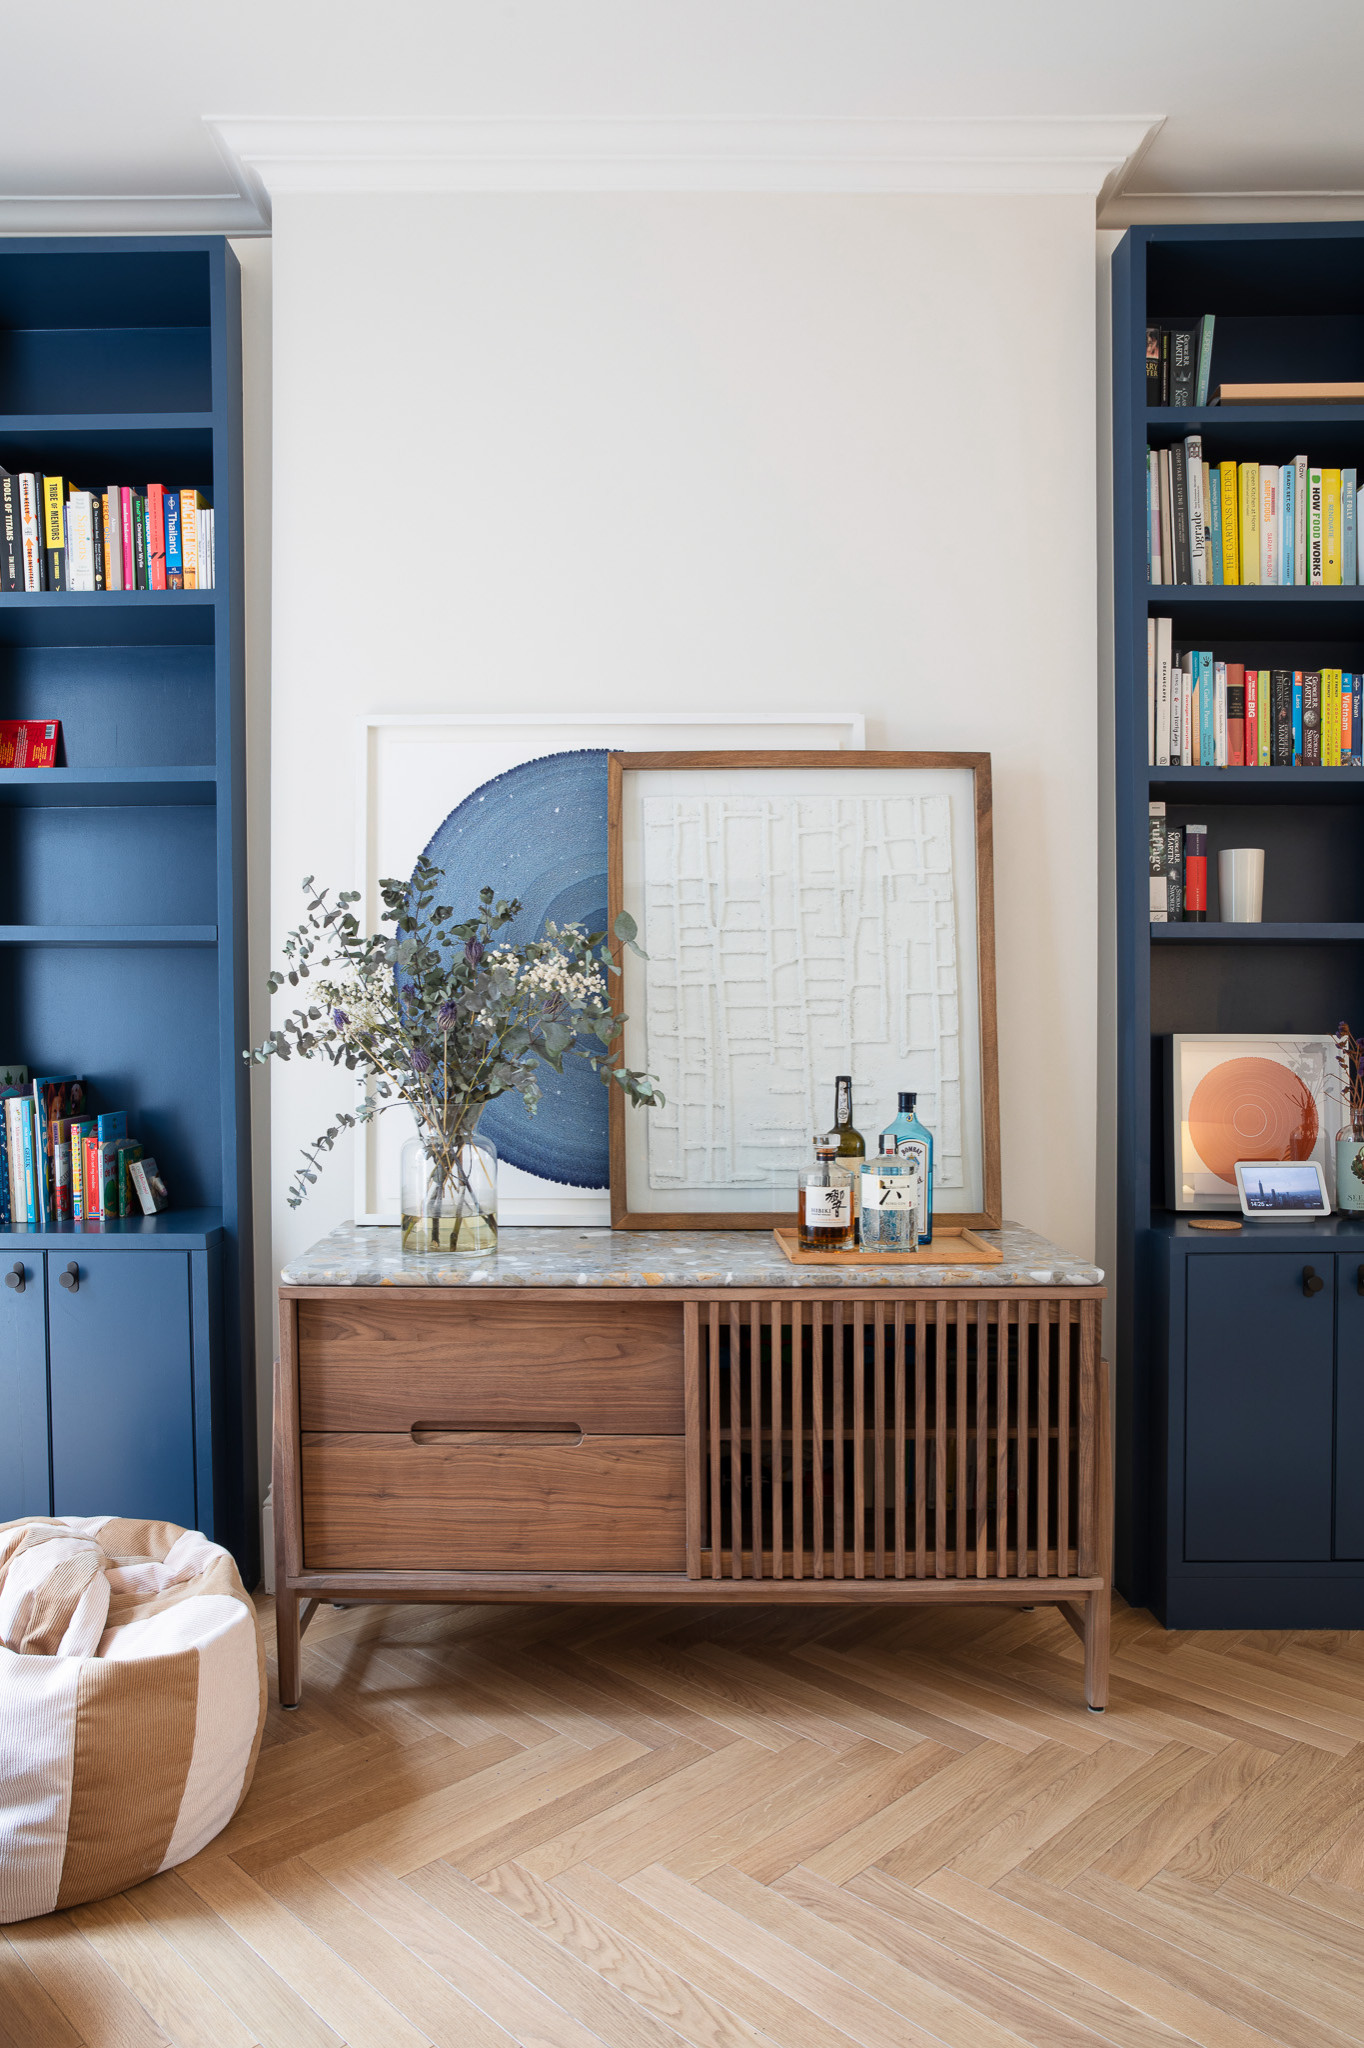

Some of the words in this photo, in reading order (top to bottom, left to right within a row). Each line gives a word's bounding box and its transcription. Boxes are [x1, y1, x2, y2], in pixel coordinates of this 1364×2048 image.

[3, 478, 11, 502] TOOLS
[49, 484, 58, 501] TRIBE
[1224, 470, 1232, 492] EDEN
[5, 504, 12, 513] OF
[1225, 494, 1232, 505] OF
[5, 515, 13, 541] TITANS
[51, 511, 59, 540] MENTORS
[74, 514, 88, 560] Sapiens
[168, 512, 178, 554] Thailand
[182, 499, 196, 567] FACTFULNESS
[1192, 511, 1205, 558] Upgrade
[1225, 508, 1233, 551] GARDENS
[1226, 554, 1234, 570] THE
[1313, 541, 1321, 577] WORKS
[1342, 695, 1350, 730] Vietnam
[1149, 821, 1163, 871] ruffage
[900, 1146, 923, 1155] BOMBAY
[878, 1179, 910, 1206] 六
